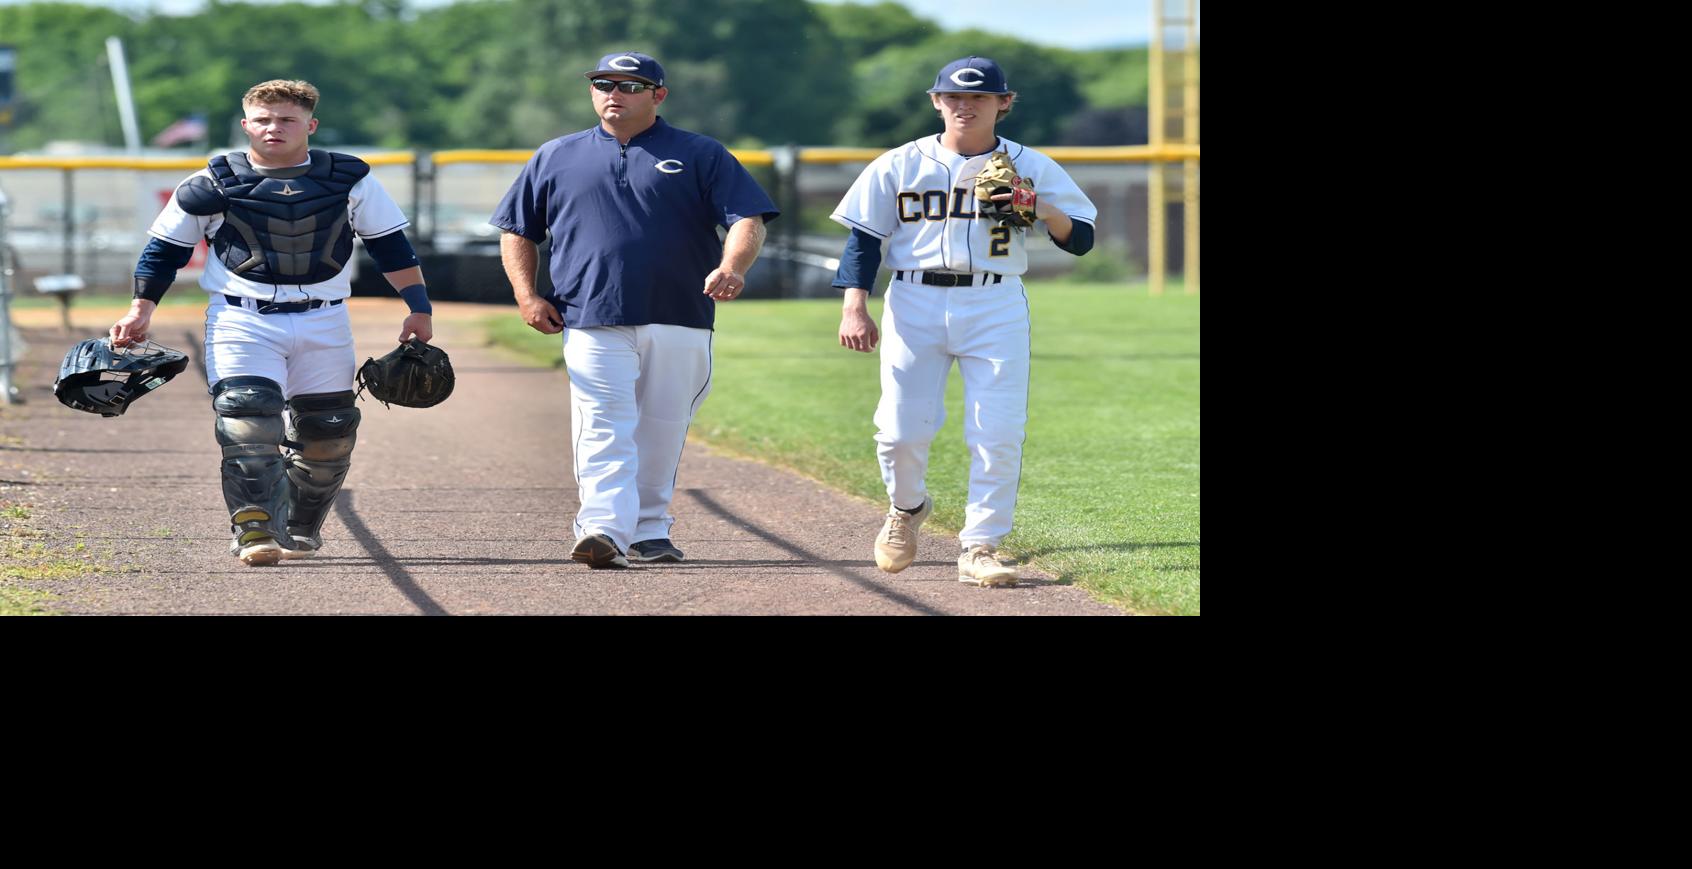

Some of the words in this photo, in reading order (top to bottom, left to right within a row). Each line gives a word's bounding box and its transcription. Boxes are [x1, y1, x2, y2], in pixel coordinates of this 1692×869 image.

[608, 55, 641, 71] C
[949, 67, 985, 87] C
[654, 159, 684, 174] C
[897, 187, 989, 222] COL
[989, 225, 1011, 258] 2
